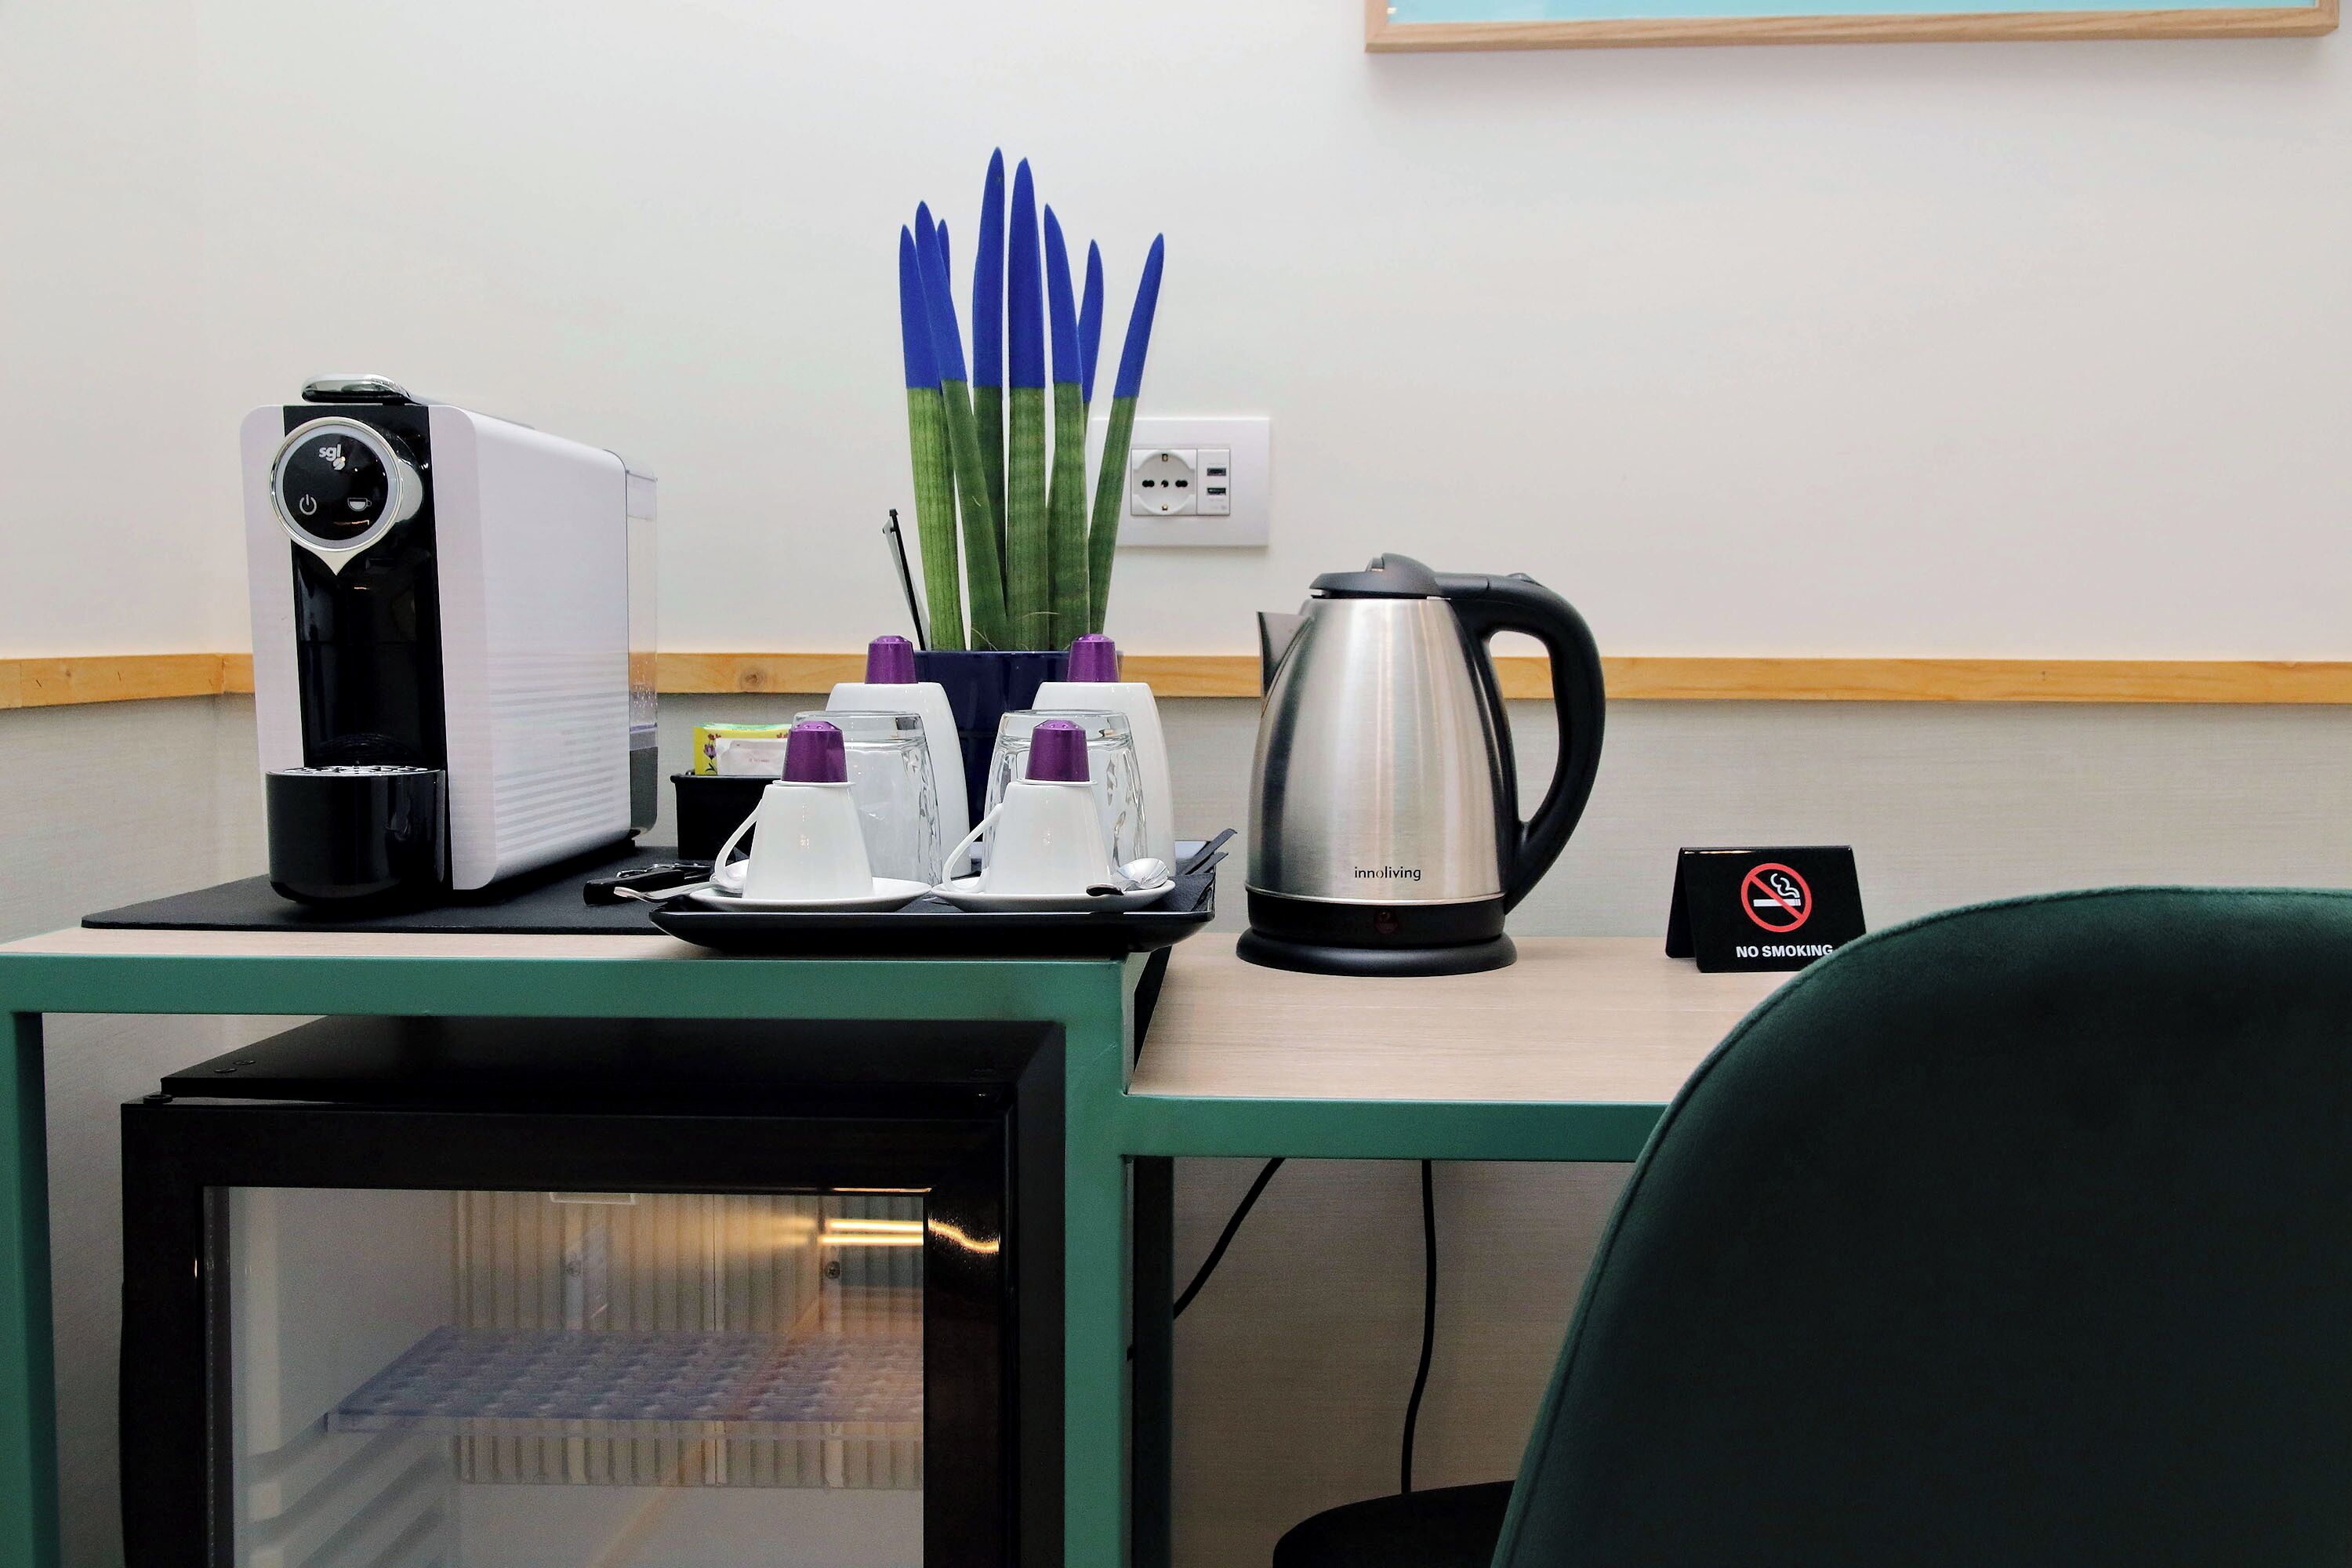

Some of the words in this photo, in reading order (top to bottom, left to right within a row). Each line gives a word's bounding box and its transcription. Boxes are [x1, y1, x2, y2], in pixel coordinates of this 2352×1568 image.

[318, 444, 342, 462] sgl
[1354, 866, 1421, 882] innoliving
[1736, 946, 1759, 958] NO
[1762, 944, 1833, 957] SMOKING
